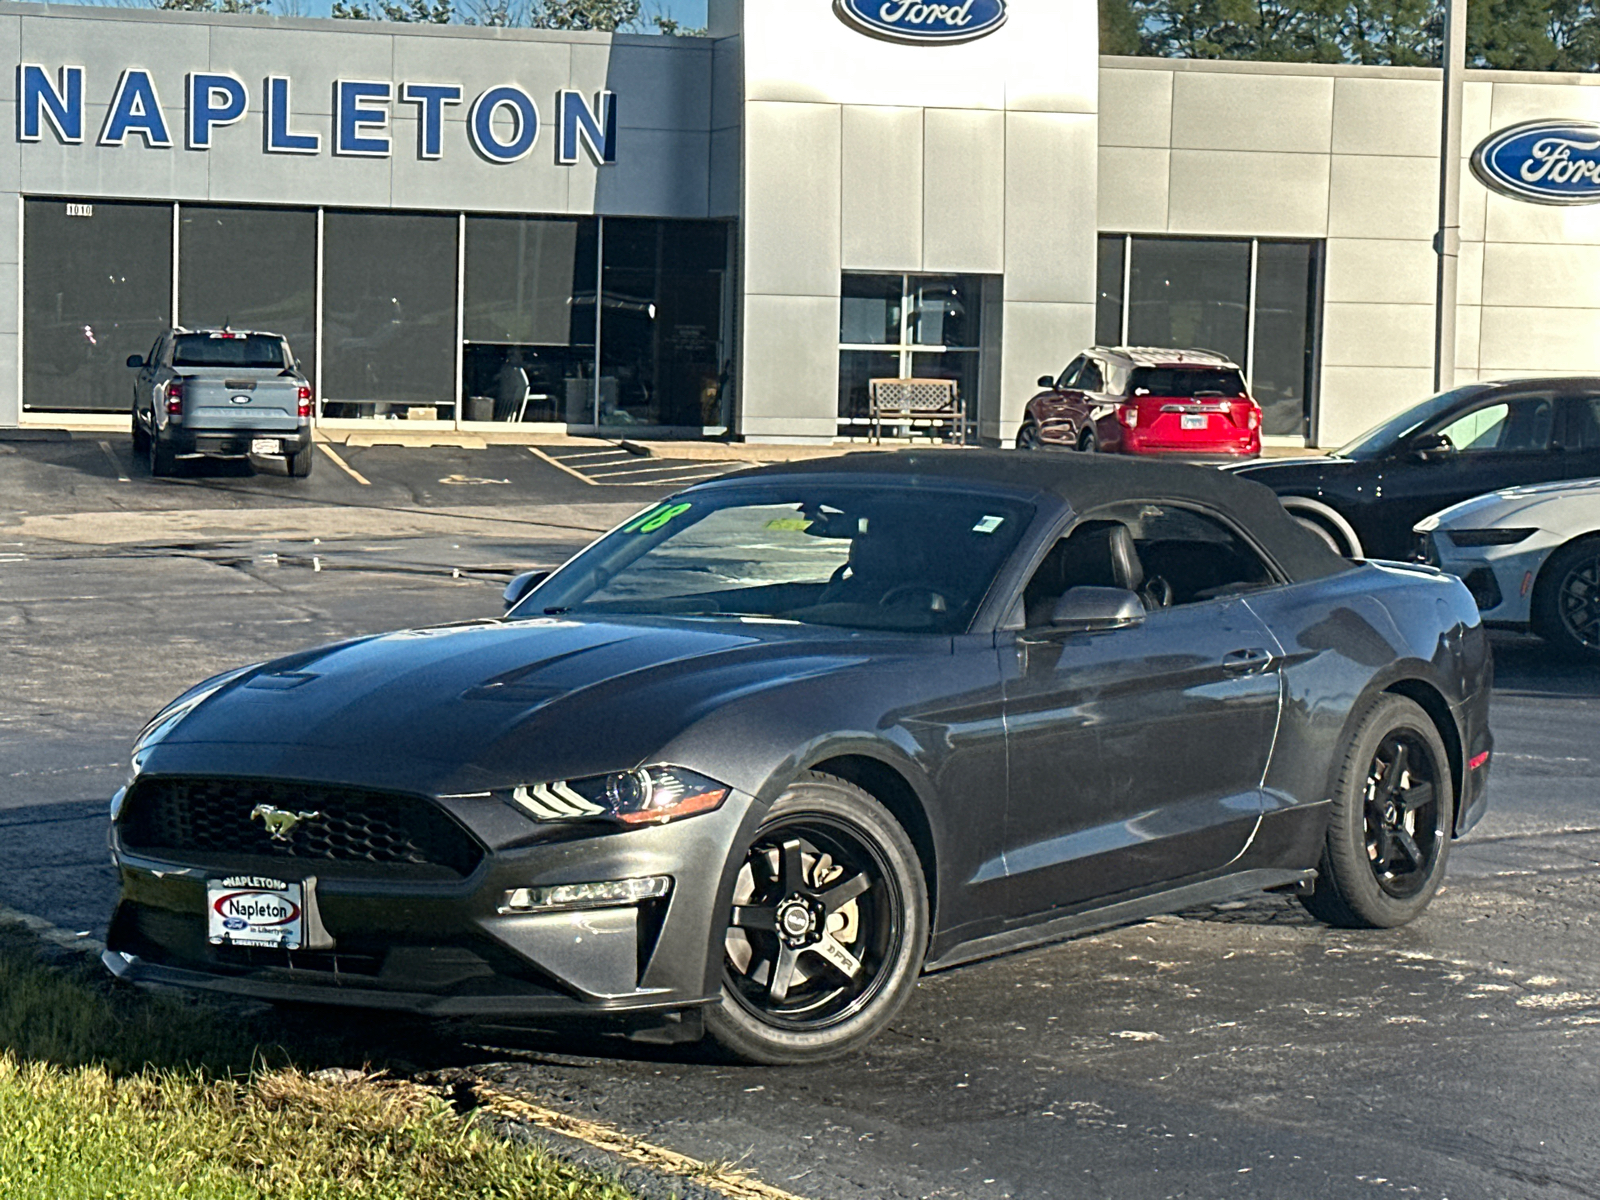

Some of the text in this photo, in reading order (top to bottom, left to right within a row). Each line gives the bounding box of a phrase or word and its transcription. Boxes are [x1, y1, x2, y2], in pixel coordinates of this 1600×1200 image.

[879, 0, 973, 26] Ford
[16, 62, 616, 165] NAPLETON
[69, 205, 91, 215] 1010
[227, 876, 281, 890] NAPLETON
[229, 899, 287, 919] Napleton
